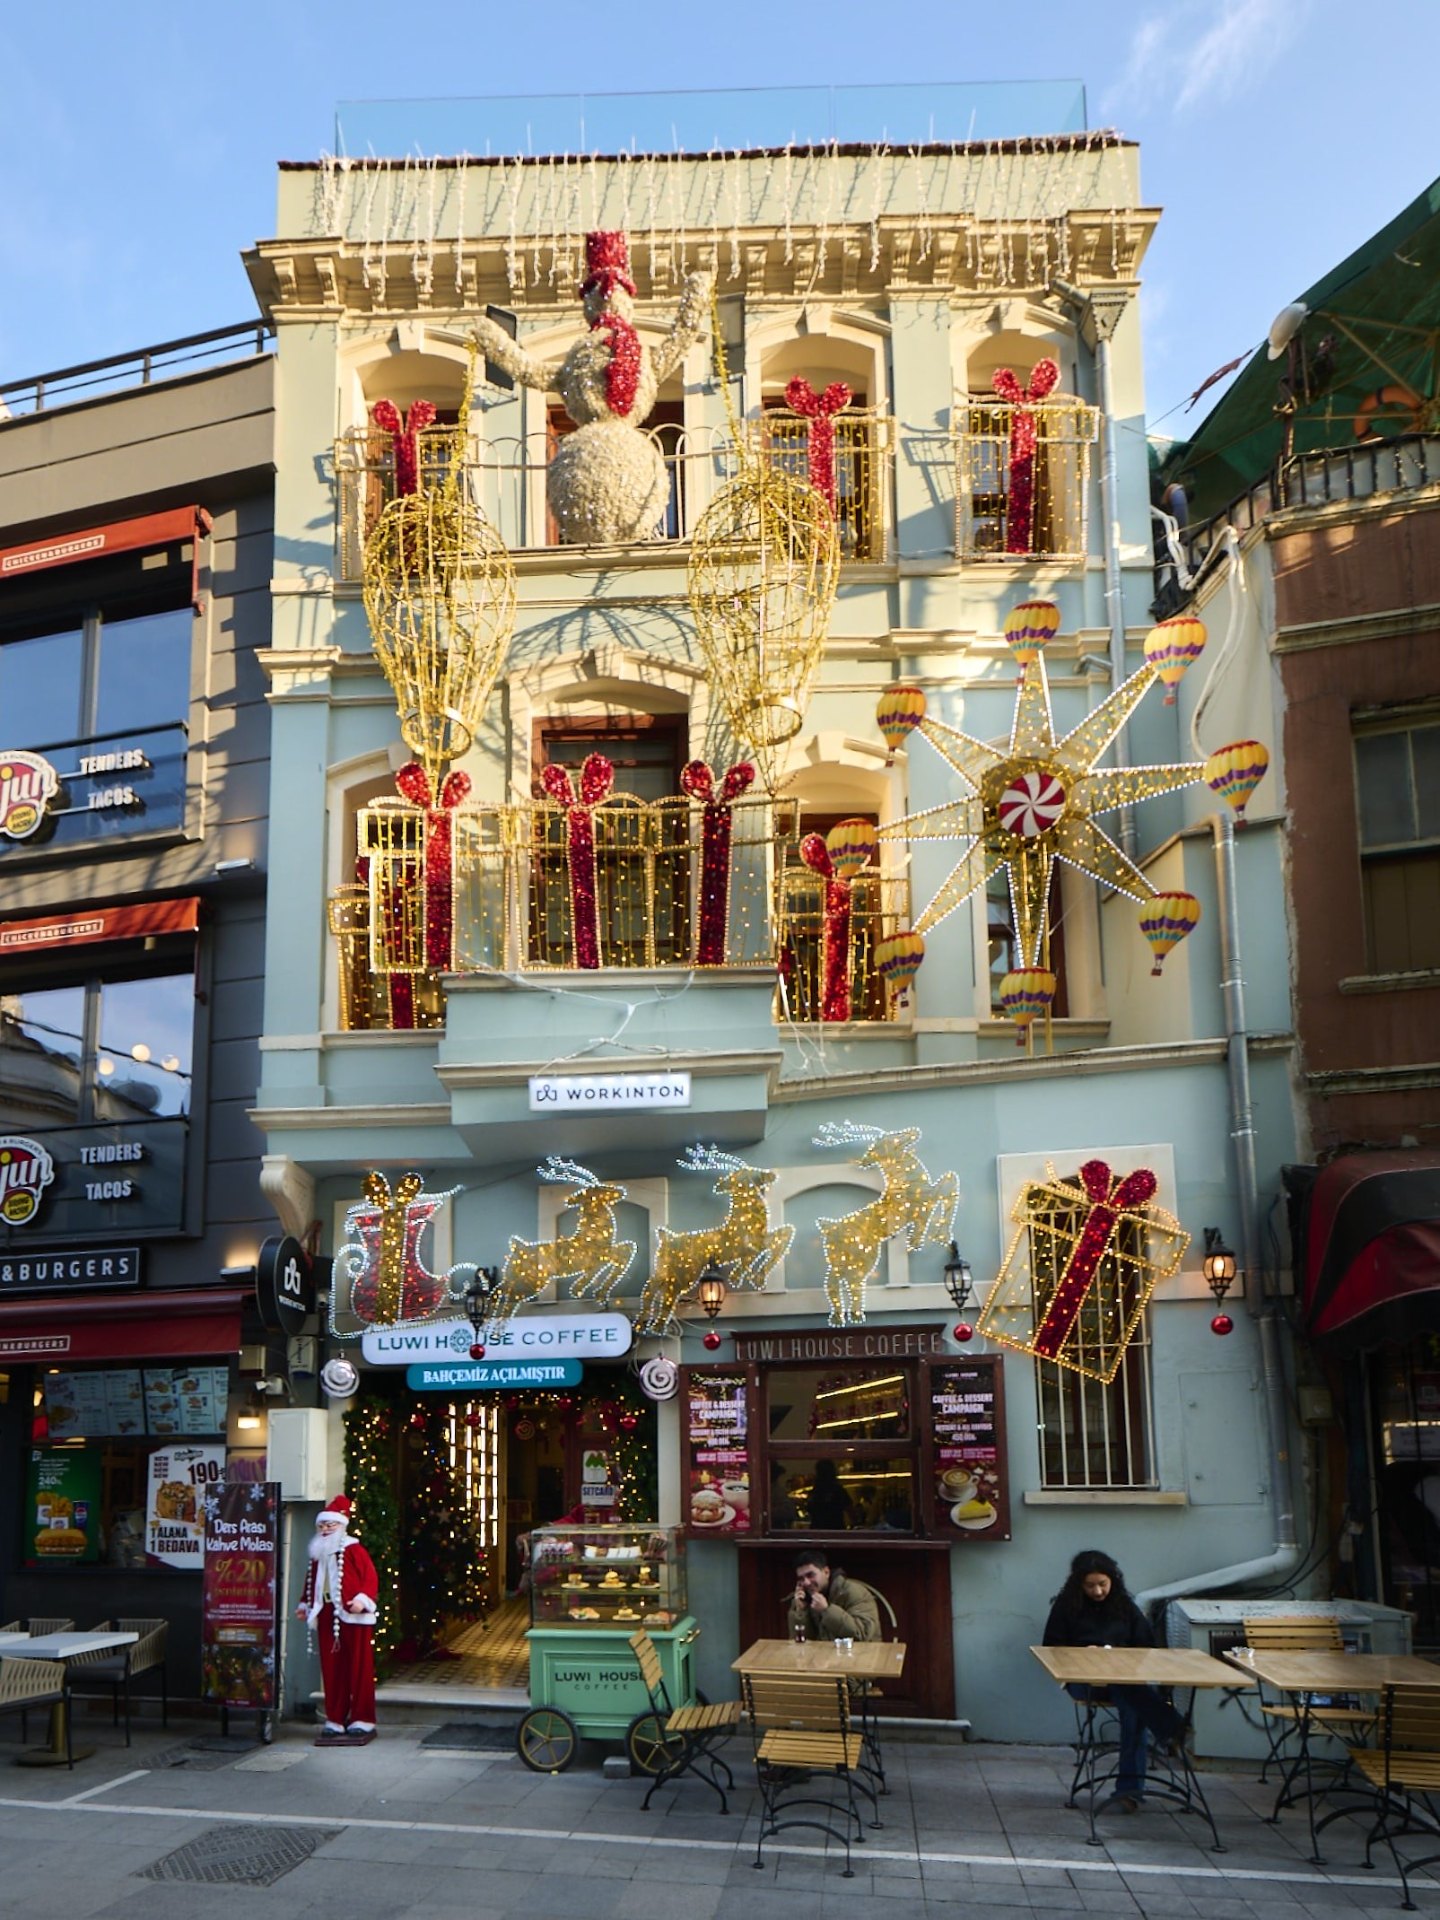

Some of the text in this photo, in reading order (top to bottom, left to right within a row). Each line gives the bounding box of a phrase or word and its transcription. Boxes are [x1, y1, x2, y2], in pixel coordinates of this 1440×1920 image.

[80, 749, 143, 774] TENDERS
[87, 786, 134, 809] TACOS
[567, 1086, 684, 1100] WORKINTON
[80, 1143, 142, 1164] TENDERS
[85, 1180, 132, 1200] TACOS
[0, 1340, 64, 1350] N&BURGERS
[378, 1337, 428, 1351] LUWI
[522, 1328, 618, 1345] COFFEE
[736, 1332, 940, 1361] LUWI HOUSE COFFEE
[423, 1365, 565, 1385] BAHÇEMİZ AÇILMIŞTIR
[699, 1410, 738, 1419] CAMPAIGN
[942, 1403, 984, 1414] CAMPAIGN
[158, 1527, 188, 1538] ALANA
[214, 1519, 238, 1534] Ders
[150, 1539, 199, 1553] 1 BEDAVA
[206, 1537, 238, 1551] Kahve
[215, 1558, 266, 1582] %20
[555, 1672, 591, 1682] LUWI
